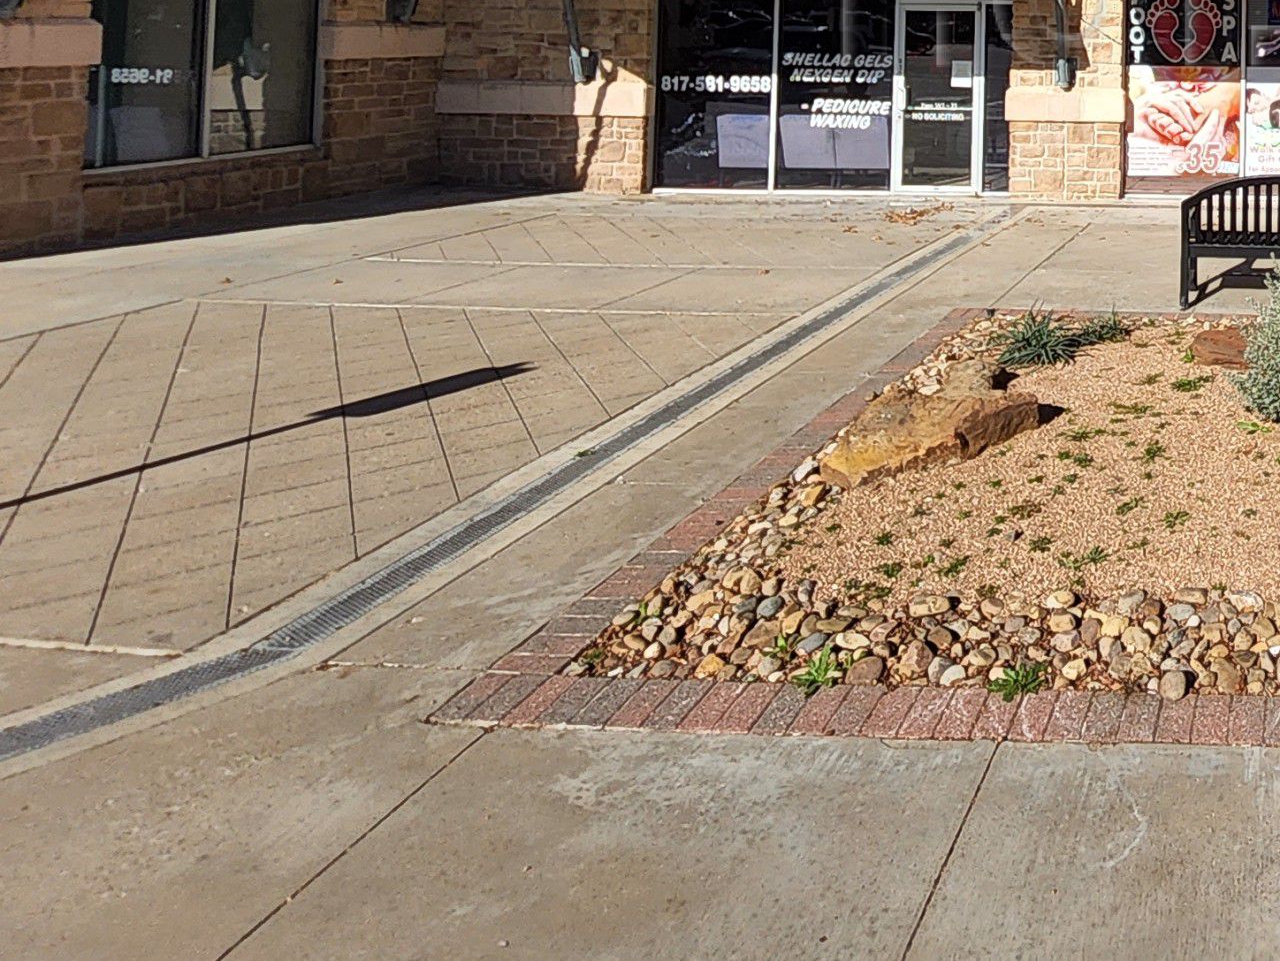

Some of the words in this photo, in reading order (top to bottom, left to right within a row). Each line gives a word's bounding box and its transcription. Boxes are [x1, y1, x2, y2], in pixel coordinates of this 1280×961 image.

[782, 52, 852, 67] SHELLAC
[854, 54, 893, 68] GELS
[790, 68, 854, 83] NEXGEN
[855, 69, 885, 84] DIP
[811, 98, 892, 115] PEDICURE
[810, 113, 871, 130] WAXING
[911, 112, 924, 121] NO
